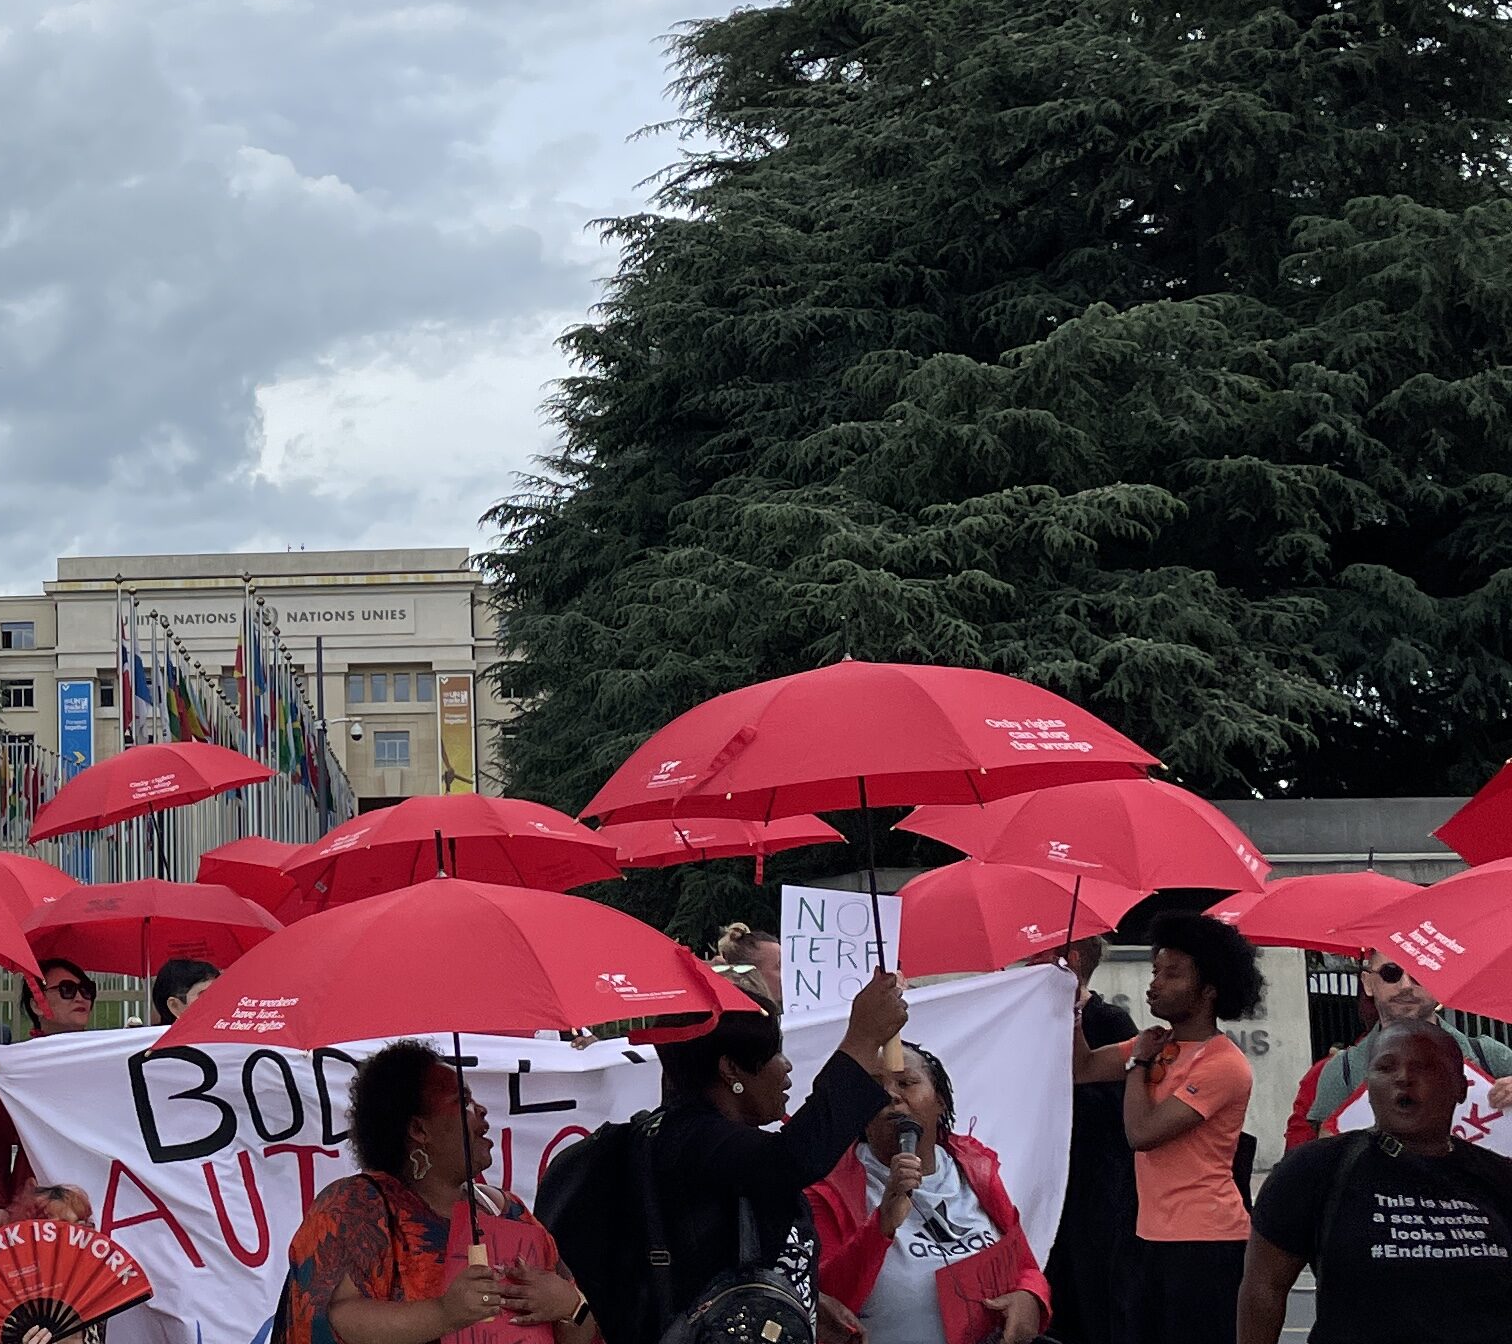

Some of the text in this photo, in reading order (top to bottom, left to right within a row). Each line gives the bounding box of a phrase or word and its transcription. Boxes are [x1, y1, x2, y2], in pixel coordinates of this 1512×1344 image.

[174, 613, 236, 625] NATIONS
[287, 609, 407, 623] NATIONS UNIES
[985, 719, 1066, 730] Only rights
[1037, 731, 1069, 741] stop
[1010, 740, 1093, 752] the wrongs
[797, 897, 870, 936] NO
[1408, 929, 1429, 946] have
[1419, 921, 1466, 954] Sex workers
[785, 935, 888, 973] TERF
[1389, 932, 1405, 944] for
[1415, 954, 1442, 971] rights
[795, 969, 863, 1001] NO
[237, 997, 300, 1007] Sex workers
[231, 1008, 256, 1018] have
[213, 1019, 286, 1033] for their rights
[1374, 1193, 1415, 1207] This
[1419, 1196, 1436, 1208] is
[1372, 1212, 1385, 1223] a
[1390, 1214, 1426, 1225] sex
[1390, 1227, 1487, 1241] looks like
[33, 1222, 57, 1242] IS
[68, 1224, 138, 1286] WORK
[1370, 1243, 1509, 1258] #Endfemicide
